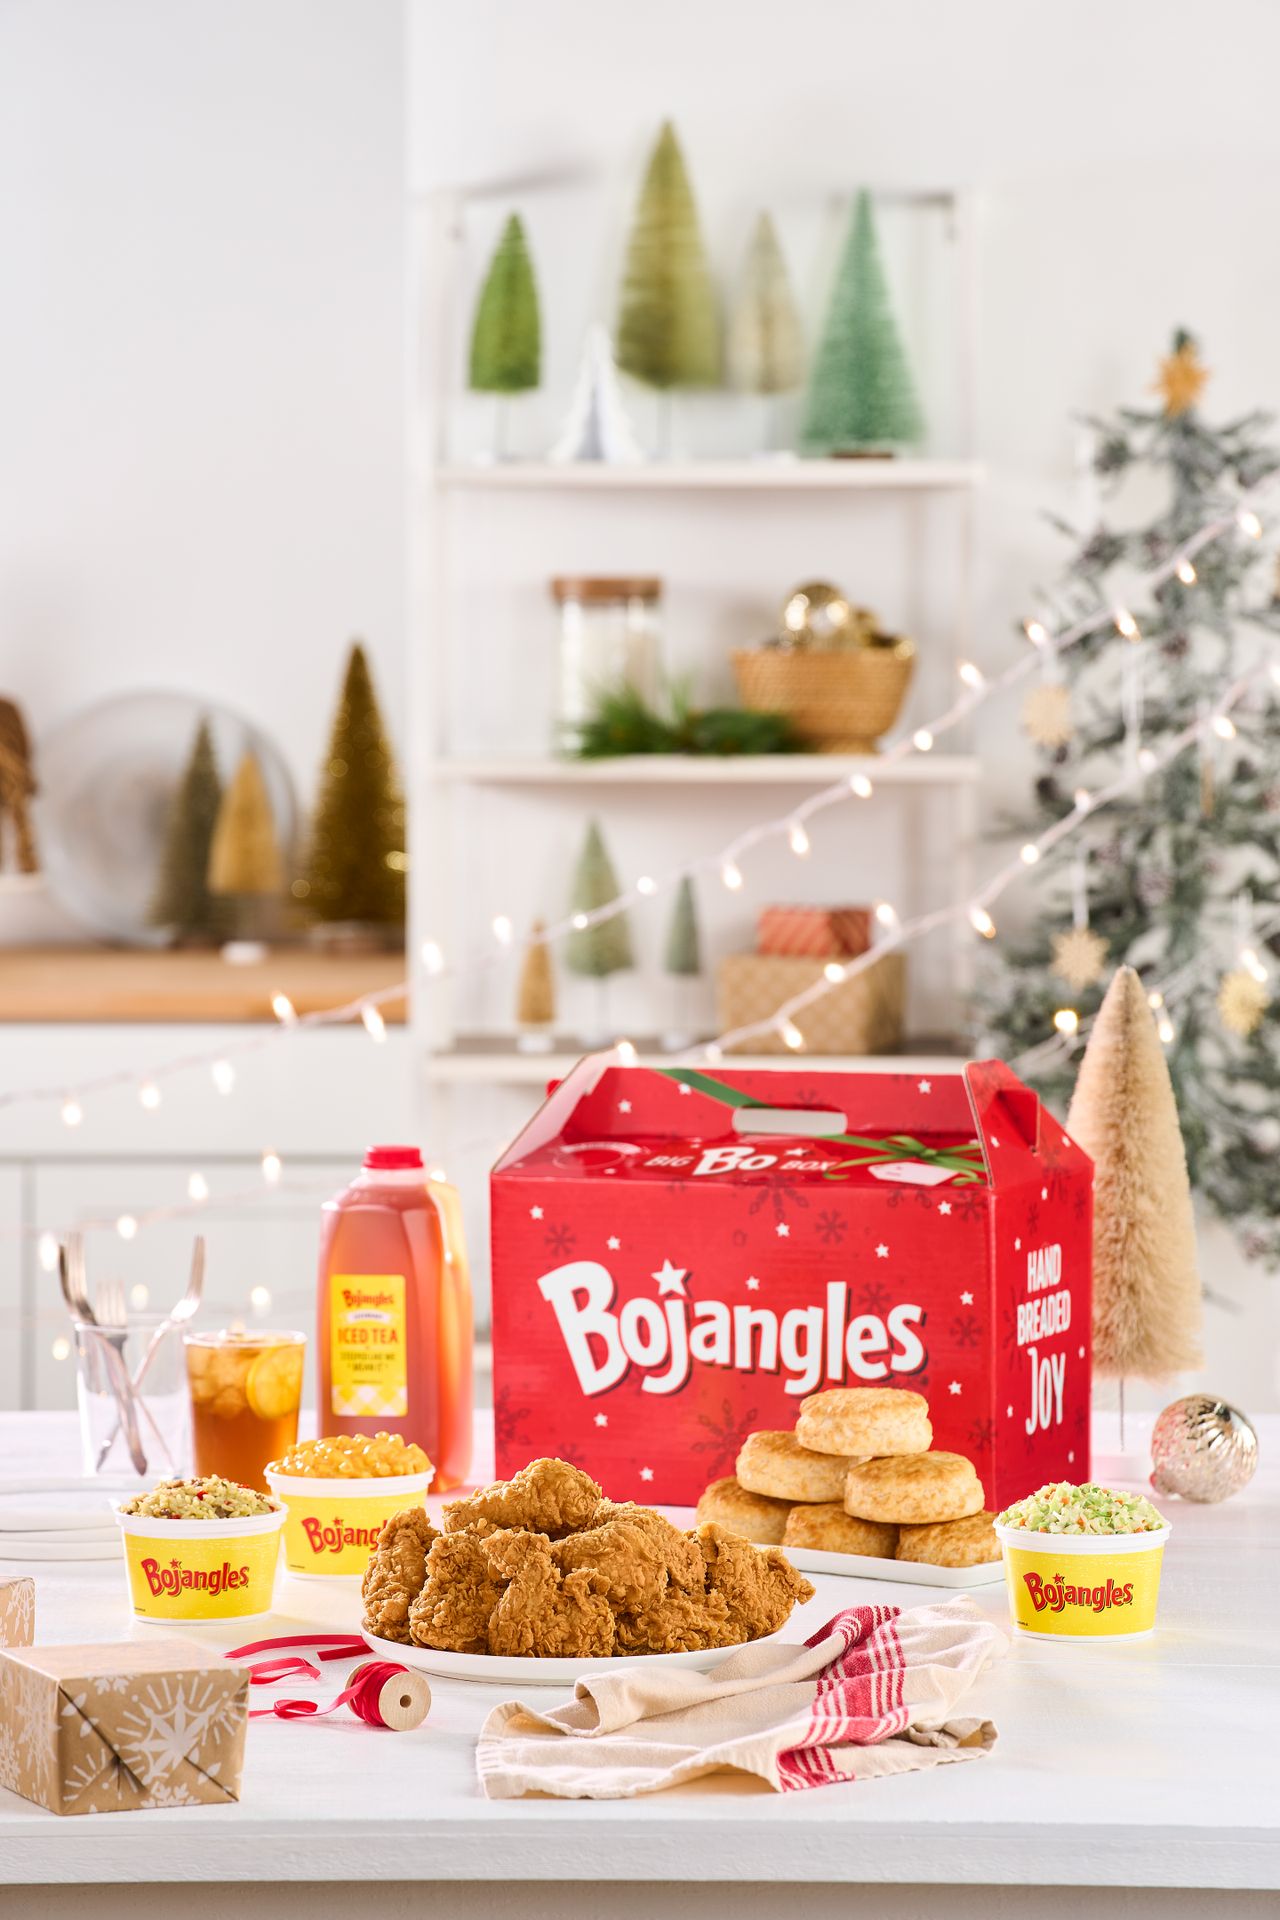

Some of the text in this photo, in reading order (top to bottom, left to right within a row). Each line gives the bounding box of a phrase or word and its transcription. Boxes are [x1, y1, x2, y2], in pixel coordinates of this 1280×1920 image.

[644, 1145, 835, 1176] BIG Bo BOX
[1027, 1243, 1062, 1293] HAND
[337, 1328, 399, 1344] ICED TEA
[537, 1259, 928, 1396] Bojangles
[1017, 1289, 1071, 1346] BREADED
[1025, 1347, 1066, 1435] JOY
[301, 1517, 388, 1553] Bojang
[141, 1558, 250, 1597] Bojangles
[1023, 1571, 1134, 1613] Bojangles
